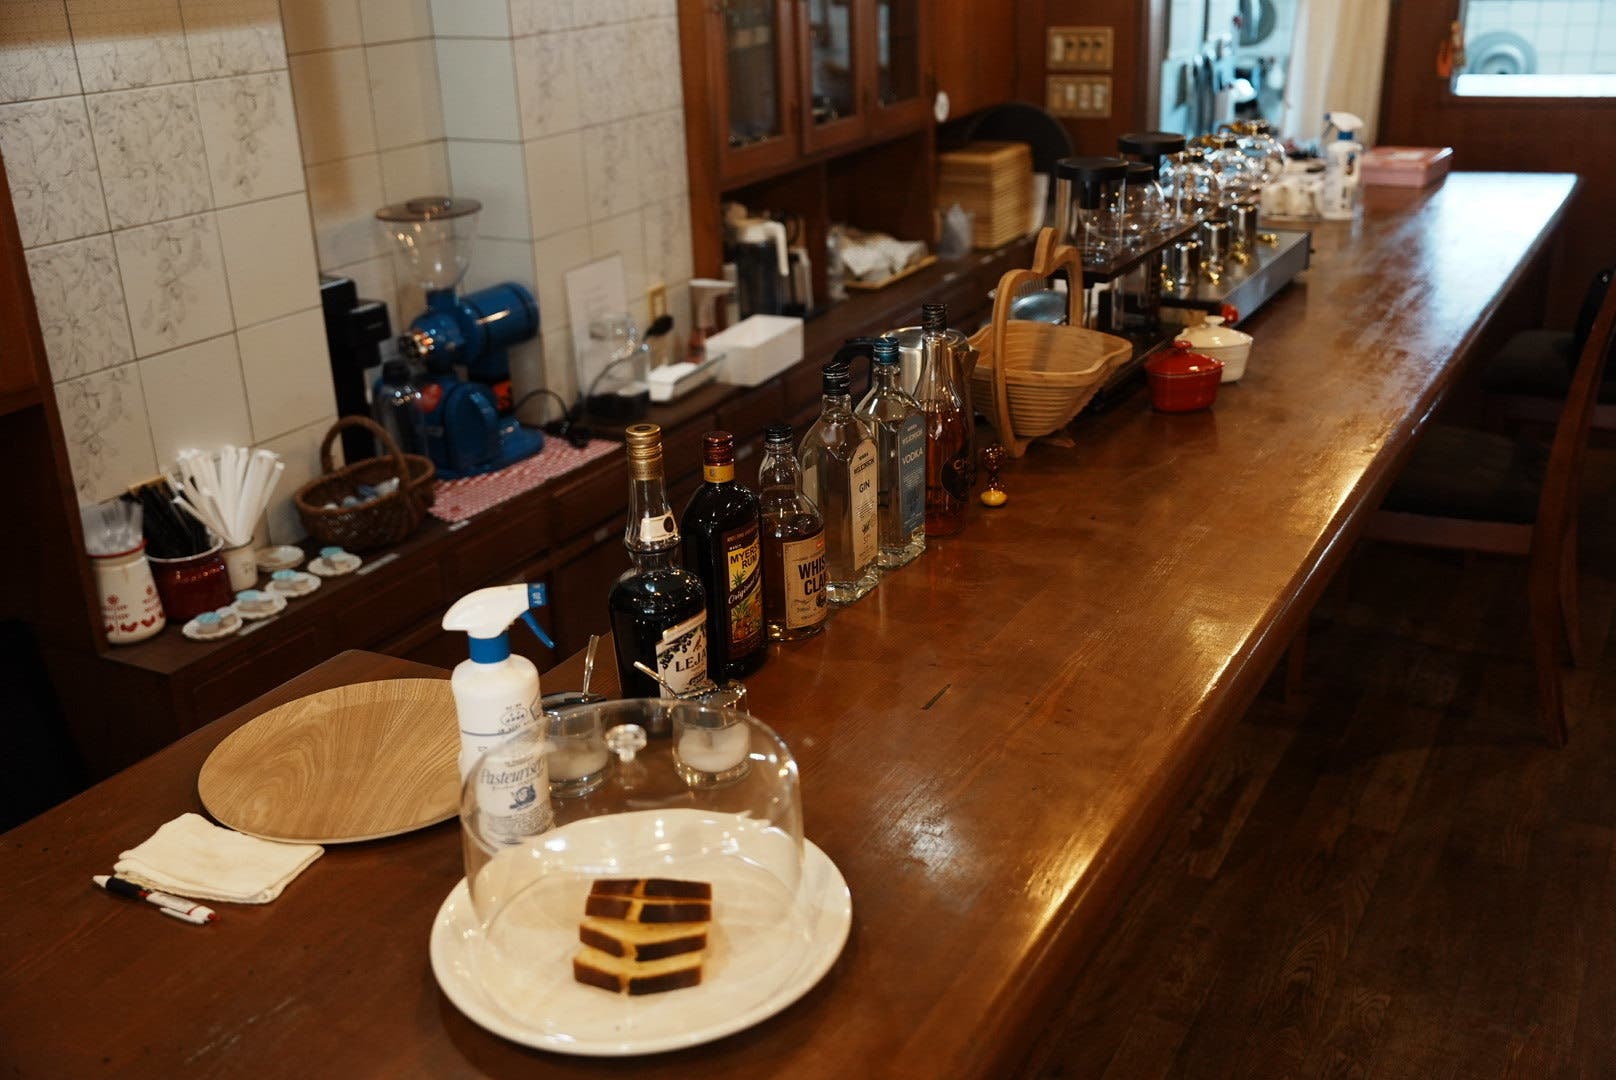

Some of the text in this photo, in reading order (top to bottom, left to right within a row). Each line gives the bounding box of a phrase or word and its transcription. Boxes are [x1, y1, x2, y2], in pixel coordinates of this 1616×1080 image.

[902, 447, 923, 465] VODKA
[859, 479, 871, 493] GIN
[742, 552, 758, 570] RUM
